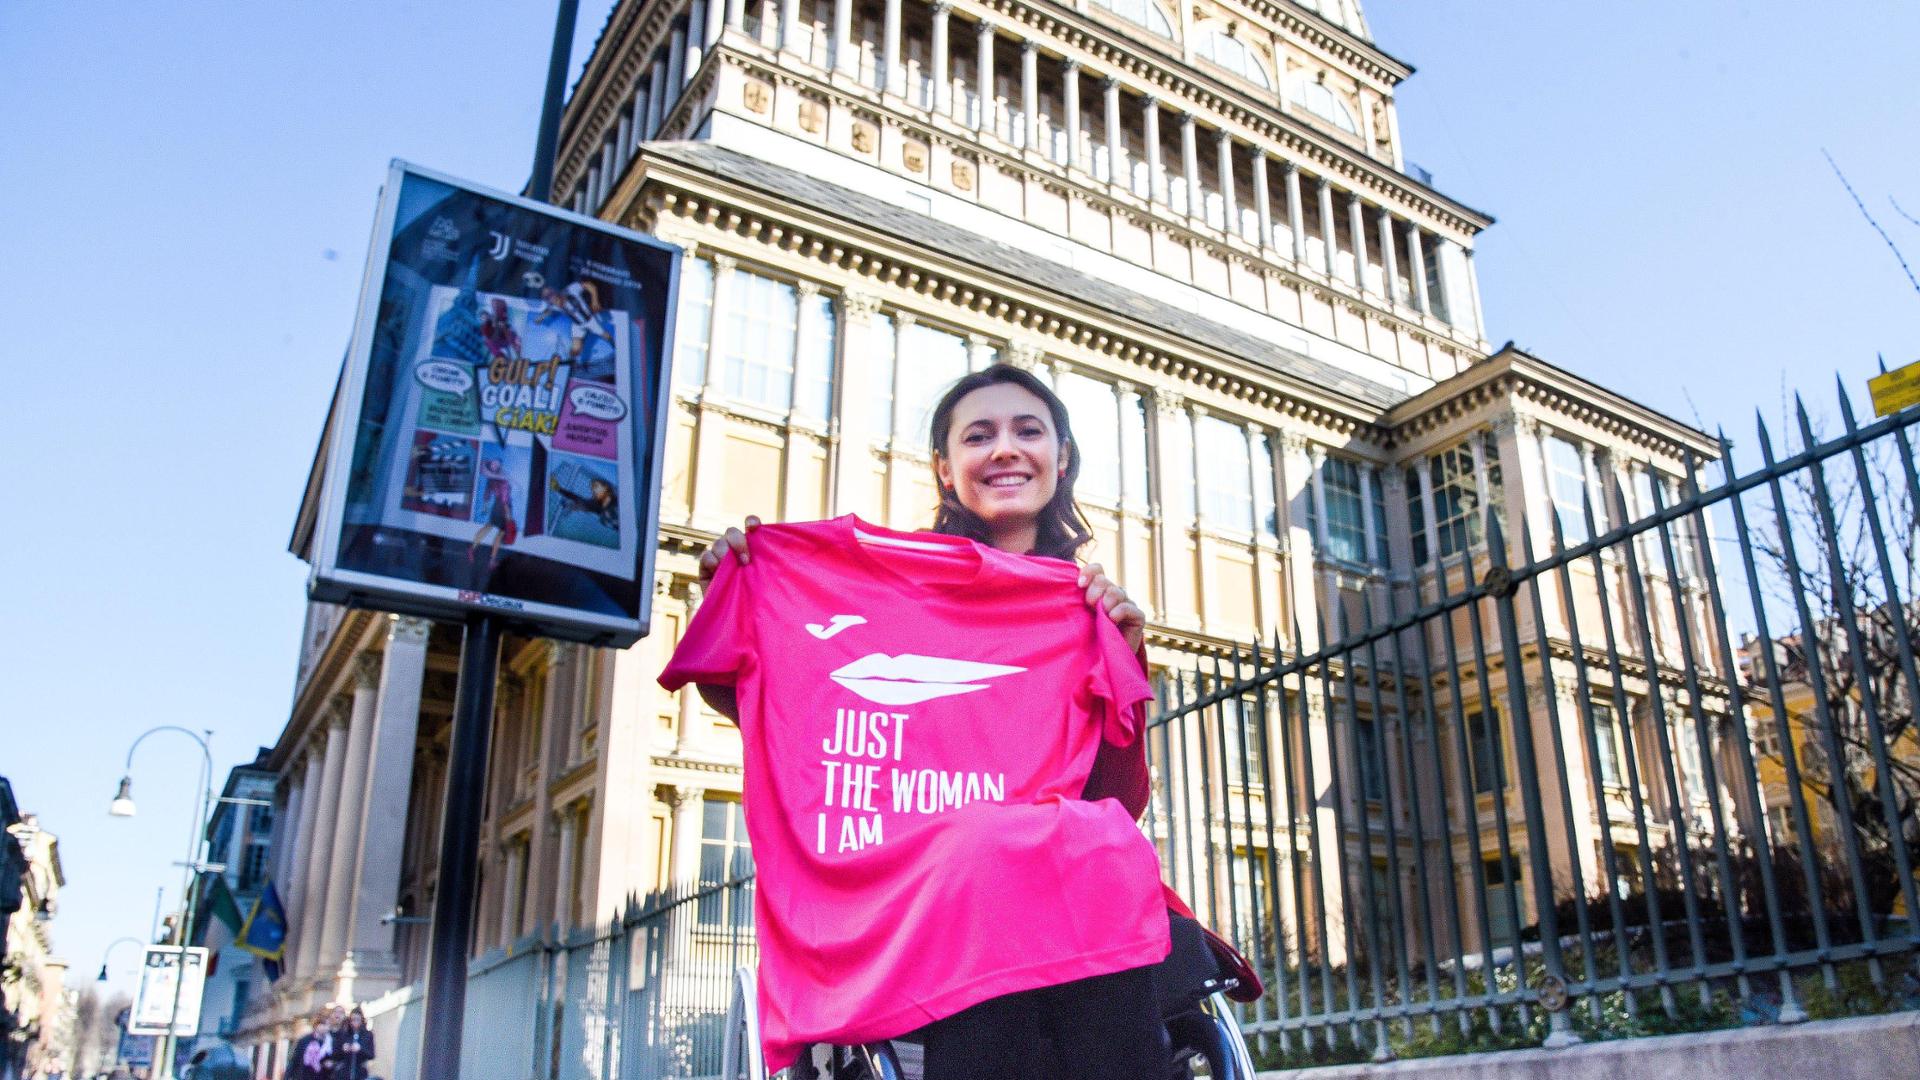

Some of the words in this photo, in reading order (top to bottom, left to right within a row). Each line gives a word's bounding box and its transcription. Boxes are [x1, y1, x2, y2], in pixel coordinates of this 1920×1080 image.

[482, 384, 560, 410] GOAL!
[822, 708, 910, 761] JUST
[821, 760, 881, 812] THE
[891, 768, 1005, 814] WOMAN
[817, 812, 826, 854] I
[838, 813, 883, 854] AM
